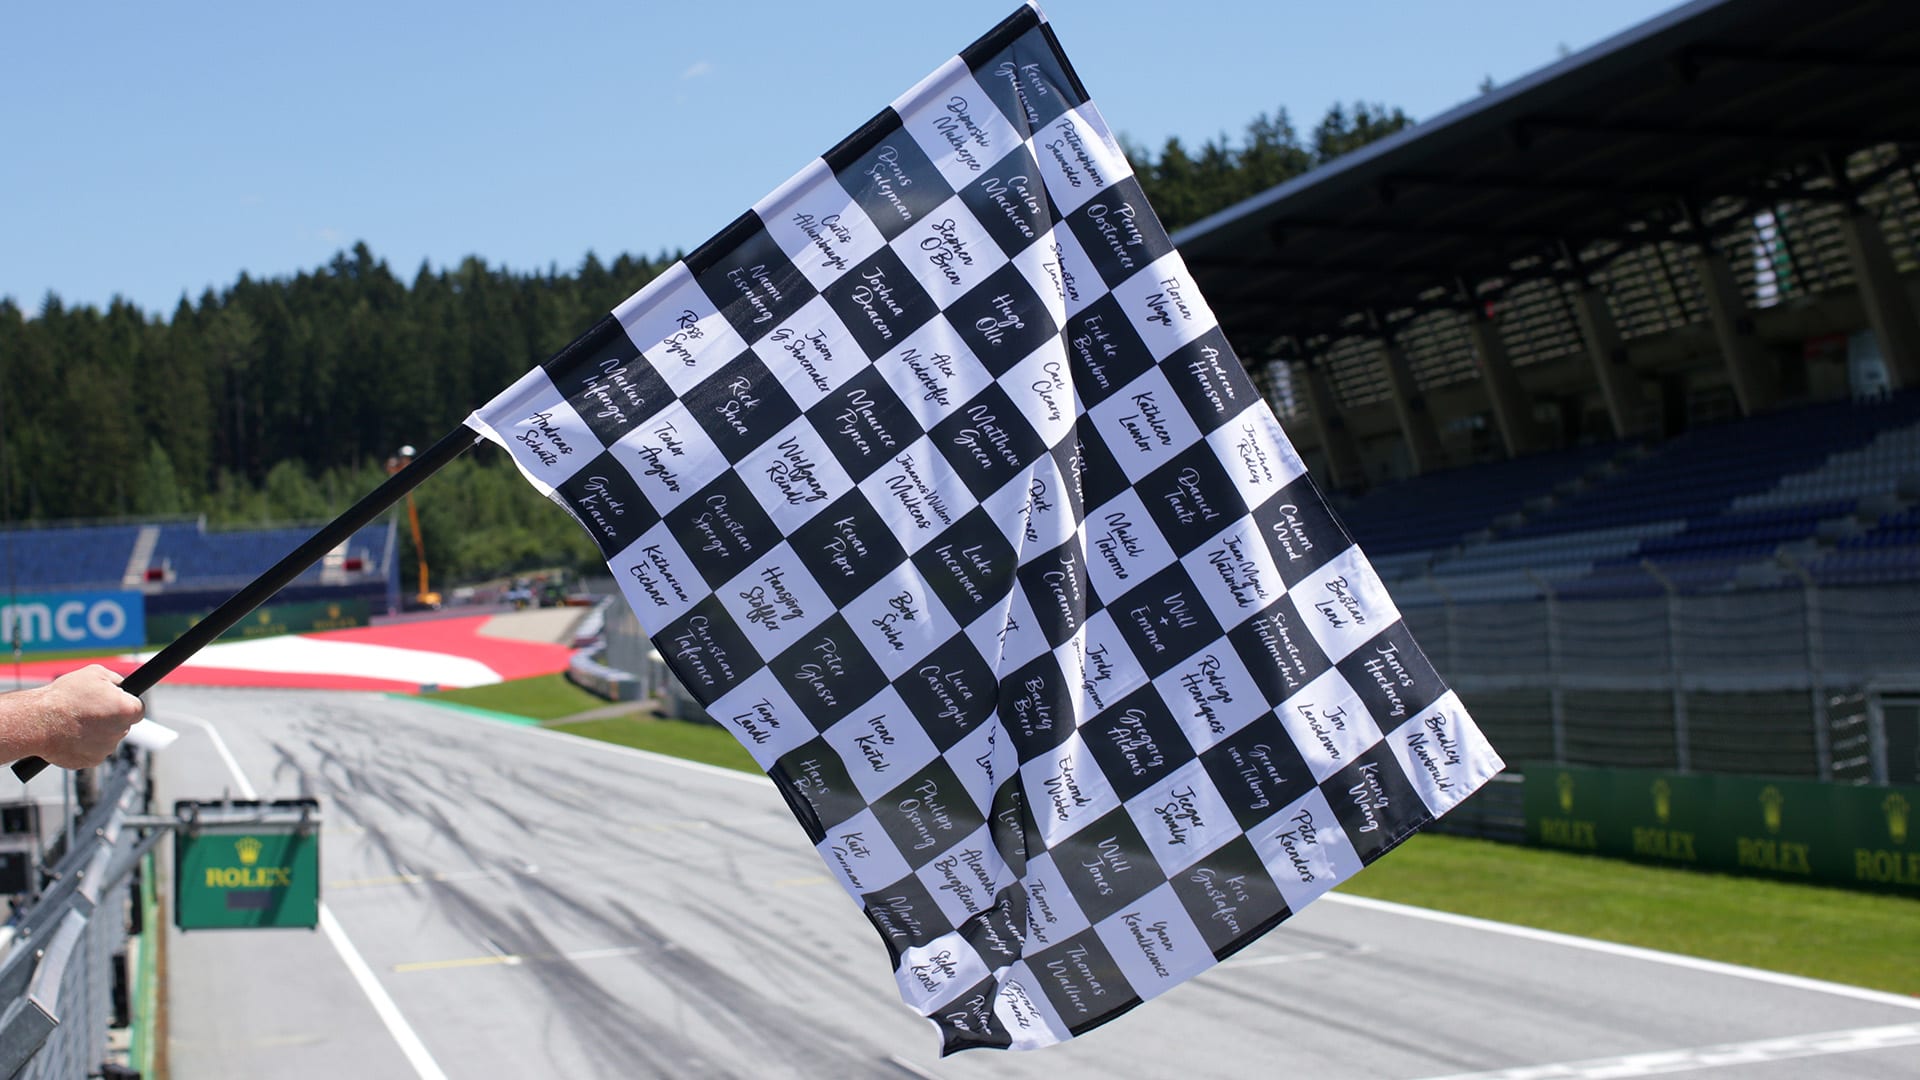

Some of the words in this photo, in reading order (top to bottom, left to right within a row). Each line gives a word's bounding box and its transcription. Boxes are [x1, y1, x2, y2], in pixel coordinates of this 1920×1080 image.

[1021, 63, 1047, 96] Kevin
[932, 117, 981, 171] Mukherjee
[878, 146, 912, 187] Denis
[1008, 176, 1041, 215] Carlos
[793, 213, 846, 271] Allumbaugh
[821, 215, 852, 244] Curtis
[931, 219, 974, 265] Stephen
[1087, 204, 1134, 269] Oosterveer
[1114, 203, 1144, 246] Perry
[750, 265, 783, 301] Naomi
[920, 237, 961, 285] O'Brien
[727, 267, 773, 324] Eisenberg
[851, 286, 893, 340] Deacon
[862, 266, 903, 317] Joshua
[992, 293, 1024, 329] Hugo
[1146, 294, 1172, 327] Noga
[1160, 276, 1192, 321] Florian
[676, 310, 704, 339] Ross
[805, 329, 832, 361] Jason
[975, 316, 1002, 346] Olle
[1084, 314, 1107, 342] Erik
[1103, 343, 1116, 357] de
[664, 333, 696, 367] Syme
[931, 352, 955, 378] Alex
[1073, 334, 1110, 389] Bourbon
[1201, 344, 1235, 399] Andrew
[600, 359, 645, 407] Markus
[729, 376, 760, 408] Rick
[1043, 362, 1064, 389] Carl
[1188, 361, 1224, 413] Hanson
[583, 376, 627, 424] Infanger
[716, 400, 748, 436] Shea
[847, 389, 896, 447] Maurice
[1032, 381, 1062, 421] Cleary
[1132, 392, 1172, 445] Kathleen
[516, 430, 557, 467] Schütz
[530, 412, 574, 456] Andreas
[654, 421, 685, 457] Teodor
[954, 429, 993, 470] Green
[967, 405, 1019, 467] Matthew
[1119, 415, 1152, 452] Lawlor
[1242, 424, 1273, 482] Jonathan
[639, 445, 680, 493] Angelov
[766, 460, 805, 505] Reindl
[777, 436, 829, 502] Wolfgang
[1236, 439, 1260, 485] Ridley
[578, 494, 617, 537] Krause
[584, 476, 624, 516] Guido
[885, 476, 932, 529] Mulkens
[1029, 479, 1052, 513] Dirk
[1178, 468, 1219, 521] Daniel
[706, 494, 752, 551] Christian
[834, 516, 868, 557] Kevan
[1105, 512, 1144, 557] Maikel
[1273, 521, 1302, 561] Wood
[1279, 504, 1313, 551] Calum
[824, 536, 855, 576] Piper
[962, 545, 992, 576] Luke
[1223, 535, 1243, 561] Juan
[630, 560, 669, 606] Eichner
[642, 545, 688, 602] Katharina
[1060, 552, 1080, 600] James
[2, 599, 125, 641] mco
[890, 591, 915, 621] Bob
[1043, 571, 1075, 629] Creamer
[1164, 592, 1198, 628] Will
[1315, 600, 1344, 629] Land
[1326, 576, 1366, 625] Bastian
[690, 616, 735, 681] Christian
[1130, 604, 1165, 652] Emma
[1270, 612, 1307, 676] Sebastian
[814, 637, 844, 677] Peter
[1086, 643, 1112, 681] Jordy
[1198, 655, 1232, 703] Rodrigo
[1377, 641, 1415, 687] James
[794, 664, 837, 707] Glaser
[919, 665, 968, 729] Casiraghi
[945, 669, 973, 700] Luca
[1025, 676, 1052, 730] Bailey
[1181, 673, 1225, 735] Henriques
[1364, 659, 1406, 717] Hockney
[733, 713, 771, 744] Landl
[752, 698, 780, 729] Tanja
[868, 714, 896, 745] Irene
[1323, 706, 1347, 731] Jon
[854, 734, 891, 772] Kartal
[1107, 727, 1146, 776] Aldous
[1120, 709, 1164, 766] Gregory
[1425, 712, 1460, 766] Bradley
[800, 759, 830, 795] Hans
[1059, 754, 1092, 806] Edmond
[1227, 747, 1244, 768] van
[1243, 766, 1270, 810] Tilborg
[1249, 744, 1288, 785] Gerard
[1407, 732, 1455, 792] Newbould
[915, 779, 952, 830] Philipp
[1044, 775, 1069, 821] Webbe
[1171, 786, 1204, 828] Jeegar
[1348, 782, 1380, 832] Wang
[1359, 762, 1390, 809] Kenny
[840, 832, 871, 859] Kurt
[1291, 809, 1318, 845] Peter
[1082, 856, 1113, 896] Jones
[1098, 836, 1132, 873] Will
[206, 867, 291, 887] ROLEX
[1225, 875, 1249, 902] Kris
[886, 896, 922, 937] Martin
[1029, 879, 1057, 924] Thomas
[1191, 868, 1240, 935] Gustafson
[1146, 921, 1174, 951] Yann
[1047, 959, 1087, 1014] Wallner
[1066, 944, 1106, 996] Thomas
